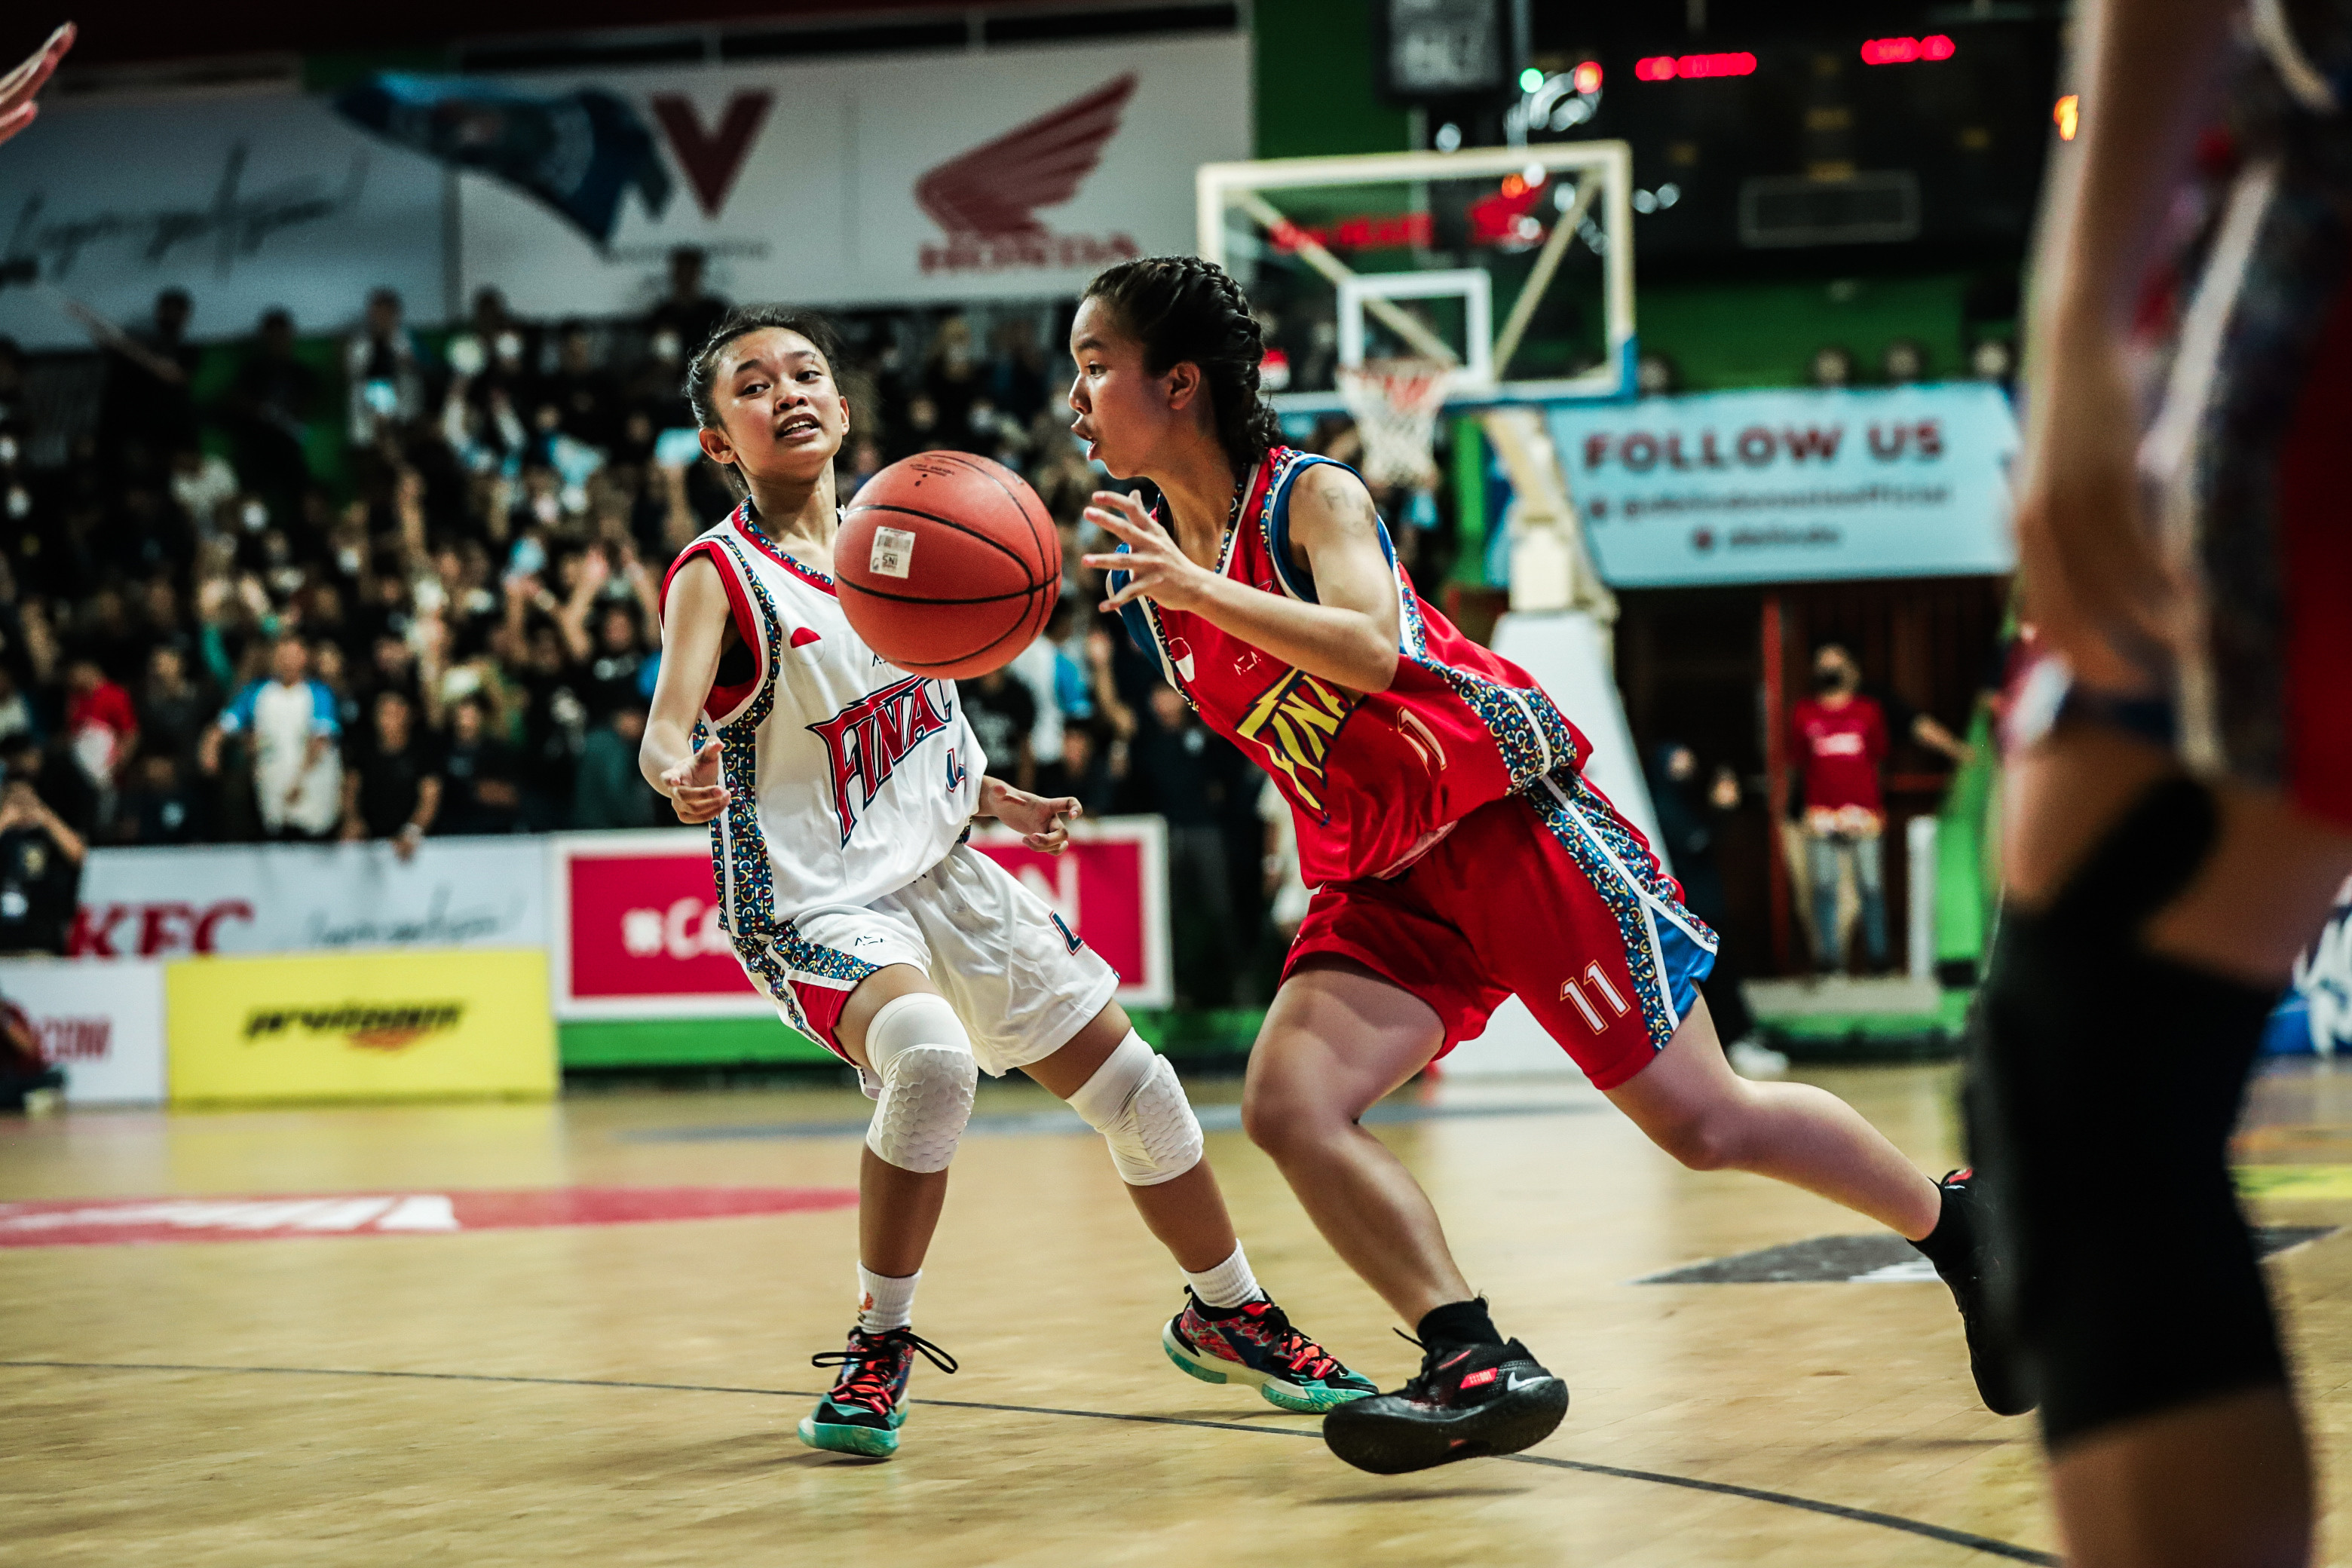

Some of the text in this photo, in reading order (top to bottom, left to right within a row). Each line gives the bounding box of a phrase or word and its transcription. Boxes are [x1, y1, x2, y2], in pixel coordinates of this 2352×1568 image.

[918, 232, 1140, 274] HONDA
[1585, 419, 1945, 473] FOLLOW US
[804, 674, 952, 850] FINA
[66, 897, 255, 958] KFC
[1559, 958, 1631, 1036] 11
